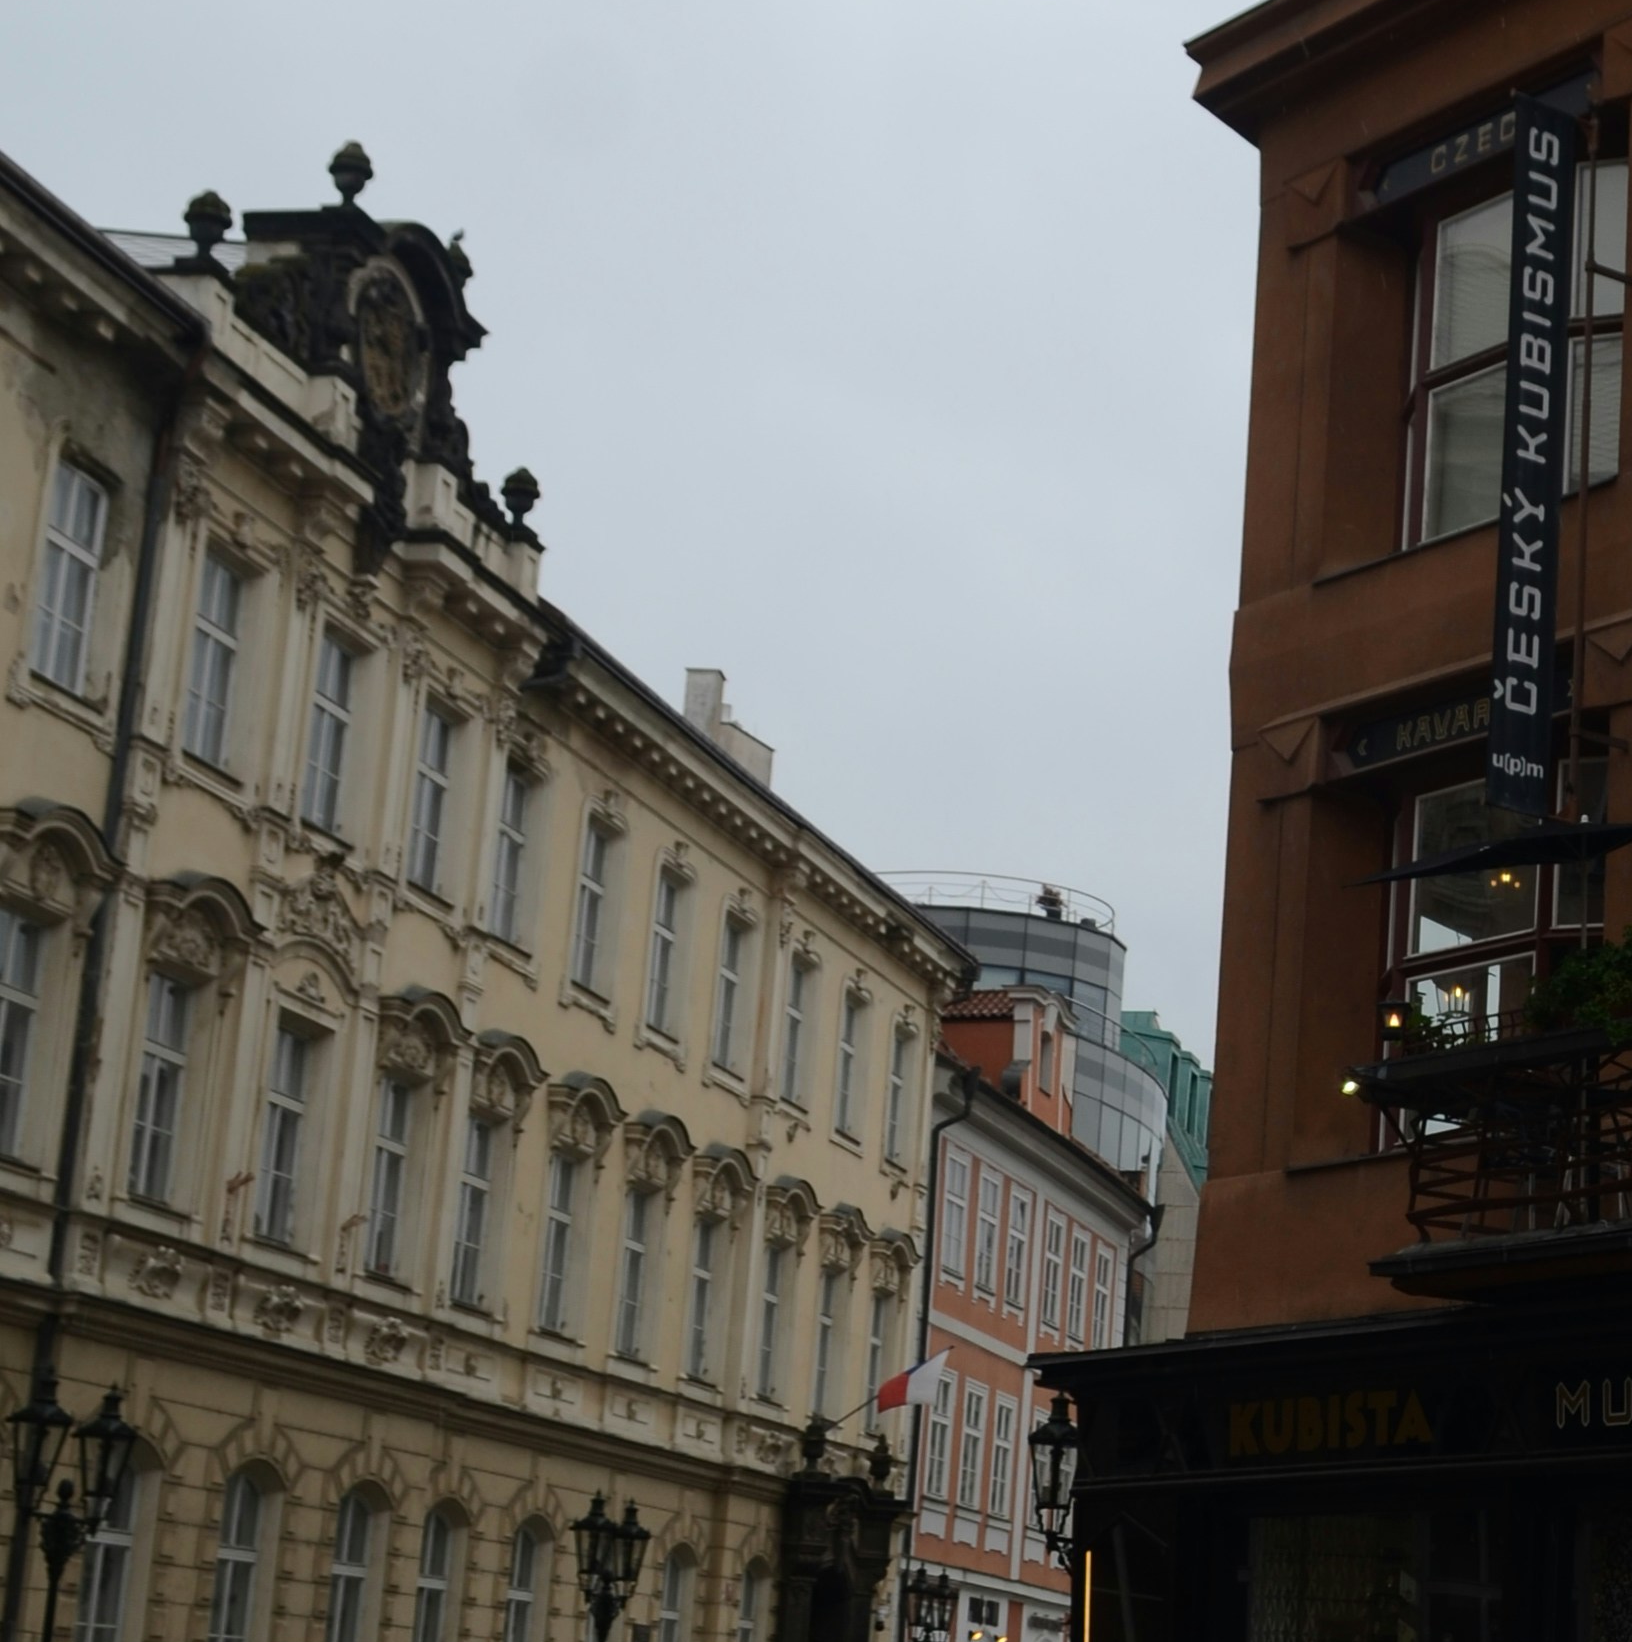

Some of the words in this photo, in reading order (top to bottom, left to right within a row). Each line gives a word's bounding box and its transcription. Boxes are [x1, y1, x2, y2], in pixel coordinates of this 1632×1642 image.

[1515, 126, 1560, 464] KUBISMUS
[1493, 486, 1546, 716] ČESKÝ
[1492, 752, 1545, 779] u(p)m
[1228, 1389, 1435, 1458] KUBISTA
